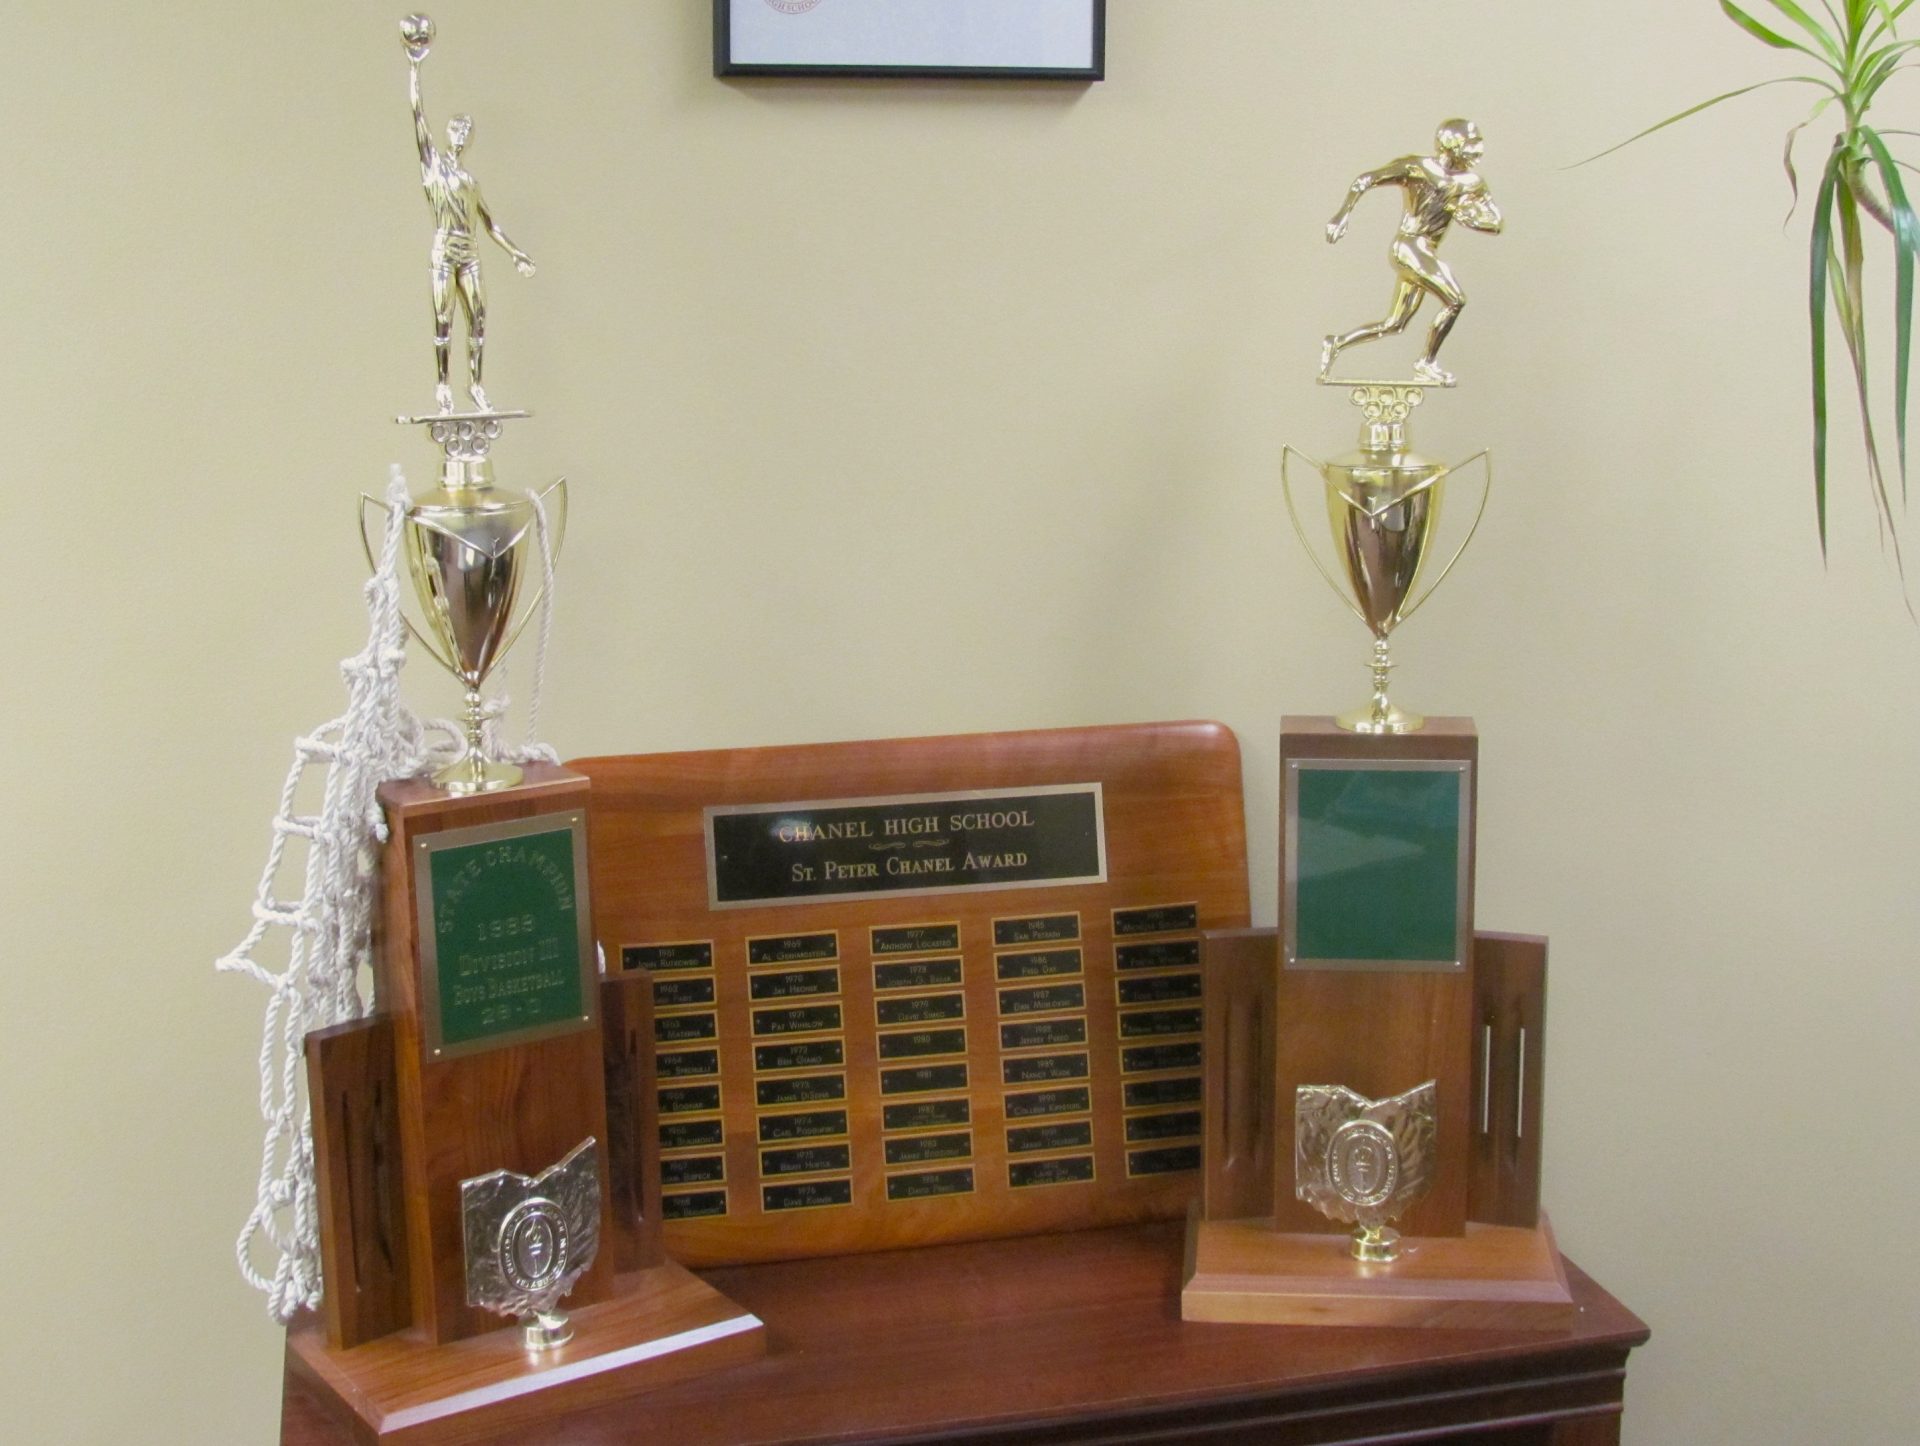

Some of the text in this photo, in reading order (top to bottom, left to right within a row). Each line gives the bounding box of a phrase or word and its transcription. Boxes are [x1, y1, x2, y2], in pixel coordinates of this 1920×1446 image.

[779, 810, 1035, 843] CHANEL HIGH SCHOOL
[791, 851, 1028, 883] ST. PETER CHANEL AWARD
[907, 930, 924, 938] 1977
[783, 940, 802, 948] 1969
[880, 942, 913, 951] ANTHONY
[785, 975, 803, 983] 1970
[1033, 990, 1050, 998] 1987
[789, 1010, 805, 1018] 1971
